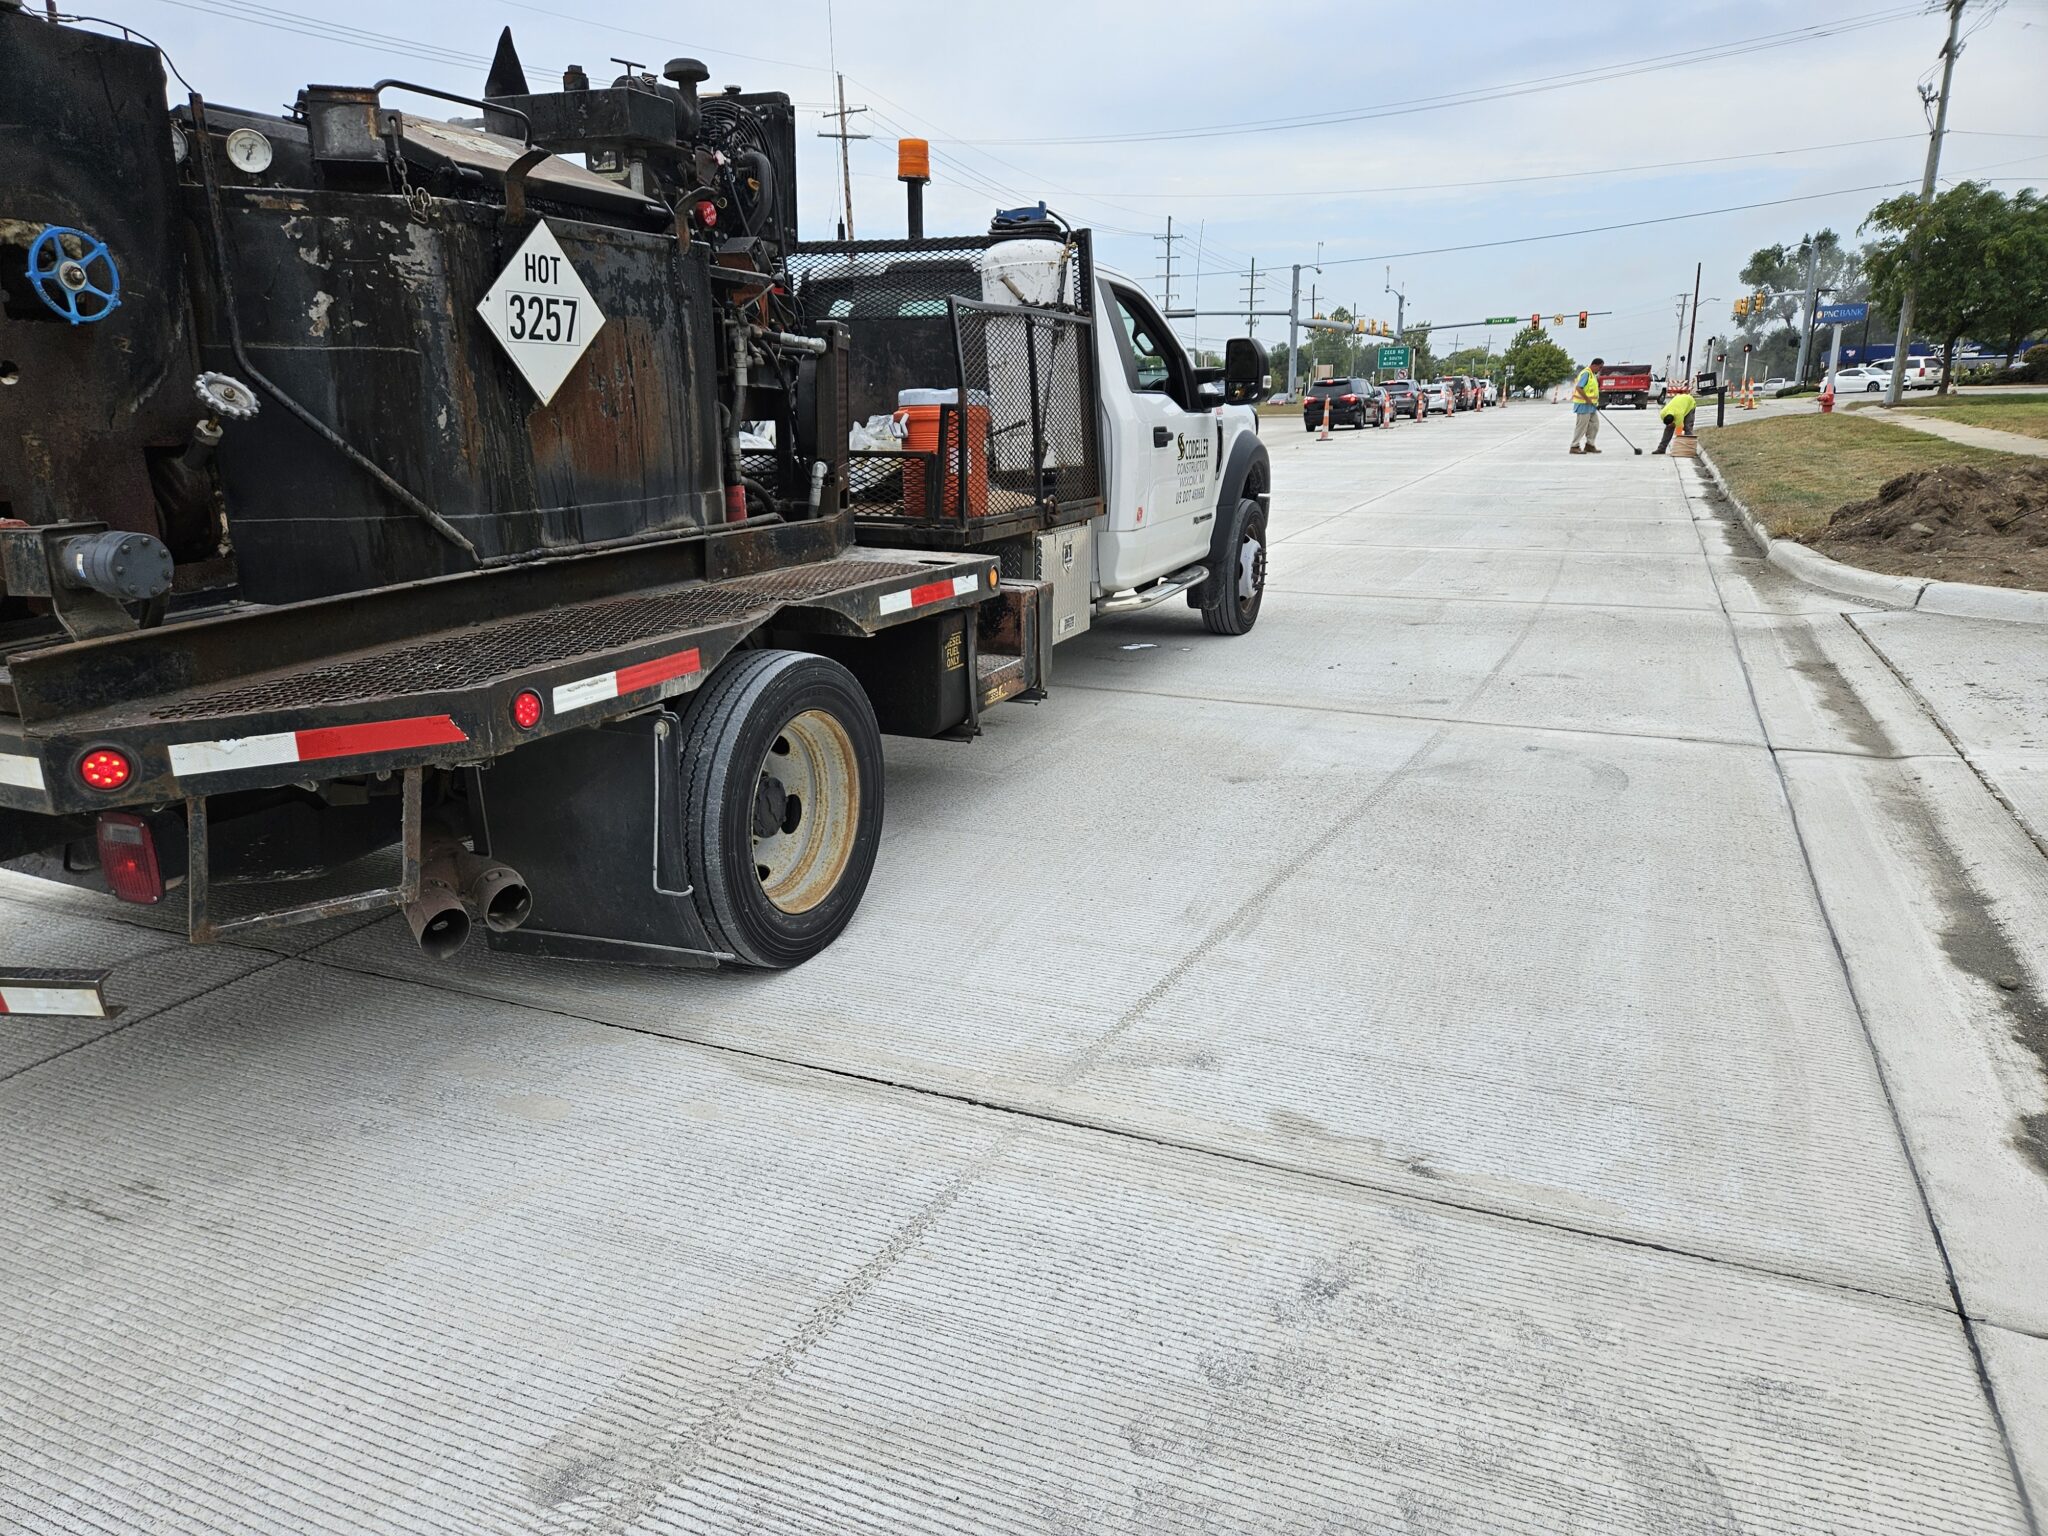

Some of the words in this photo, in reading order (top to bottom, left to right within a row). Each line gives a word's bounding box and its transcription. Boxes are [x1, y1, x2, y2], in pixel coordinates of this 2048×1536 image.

[525, 253, 560, 284] HOT
[509, 294, 577, 342] 3257
[1823, 310, 1840, 318] PNC
[1840, 308, 1864, 317] BANK
[1177, 460, 1208, 475] CONSTRUCTION
[946, 646, 960, 658] FUEL
[946, 655, 960, 668] ONLY
